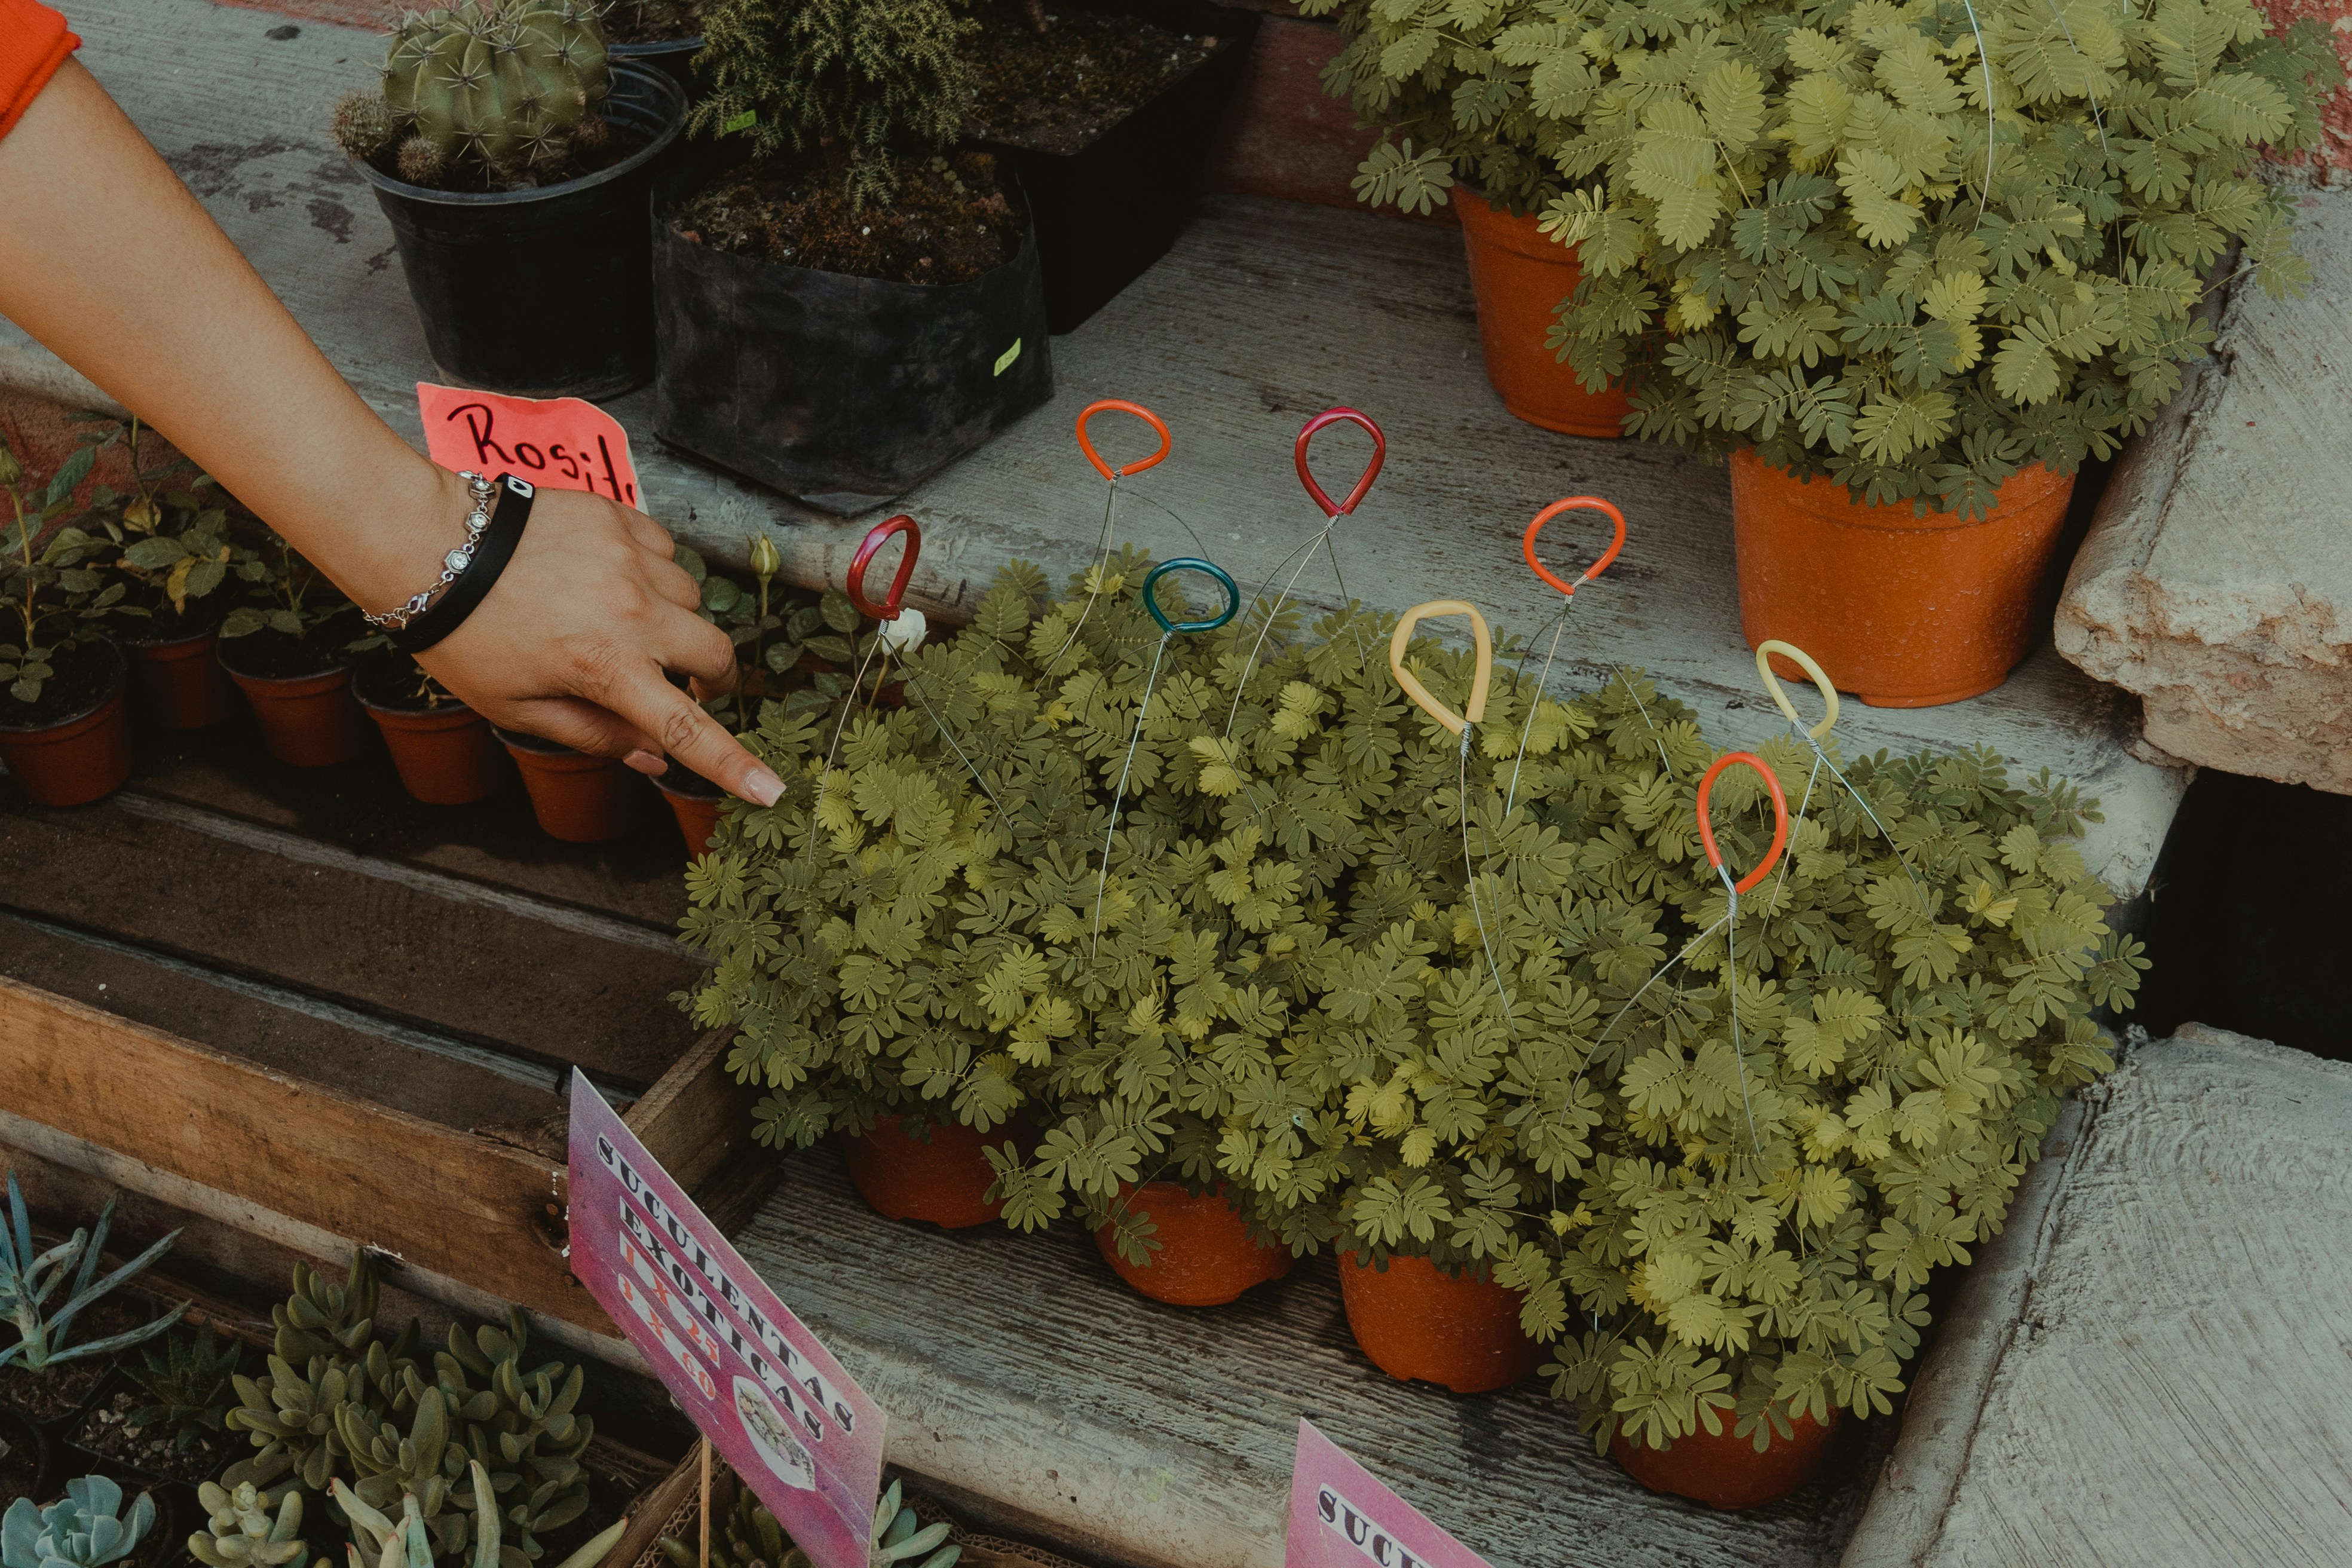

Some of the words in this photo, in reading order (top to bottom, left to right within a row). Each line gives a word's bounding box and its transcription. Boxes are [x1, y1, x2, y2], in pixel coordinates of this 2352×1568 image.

[598, 1137, 853, 1432] SUCULENTAS
[620, 1273, 633, 1301] 3
[621, 1198, 821, 1440] EXOTICAS
[685, 1315, 718, 1362] 25
